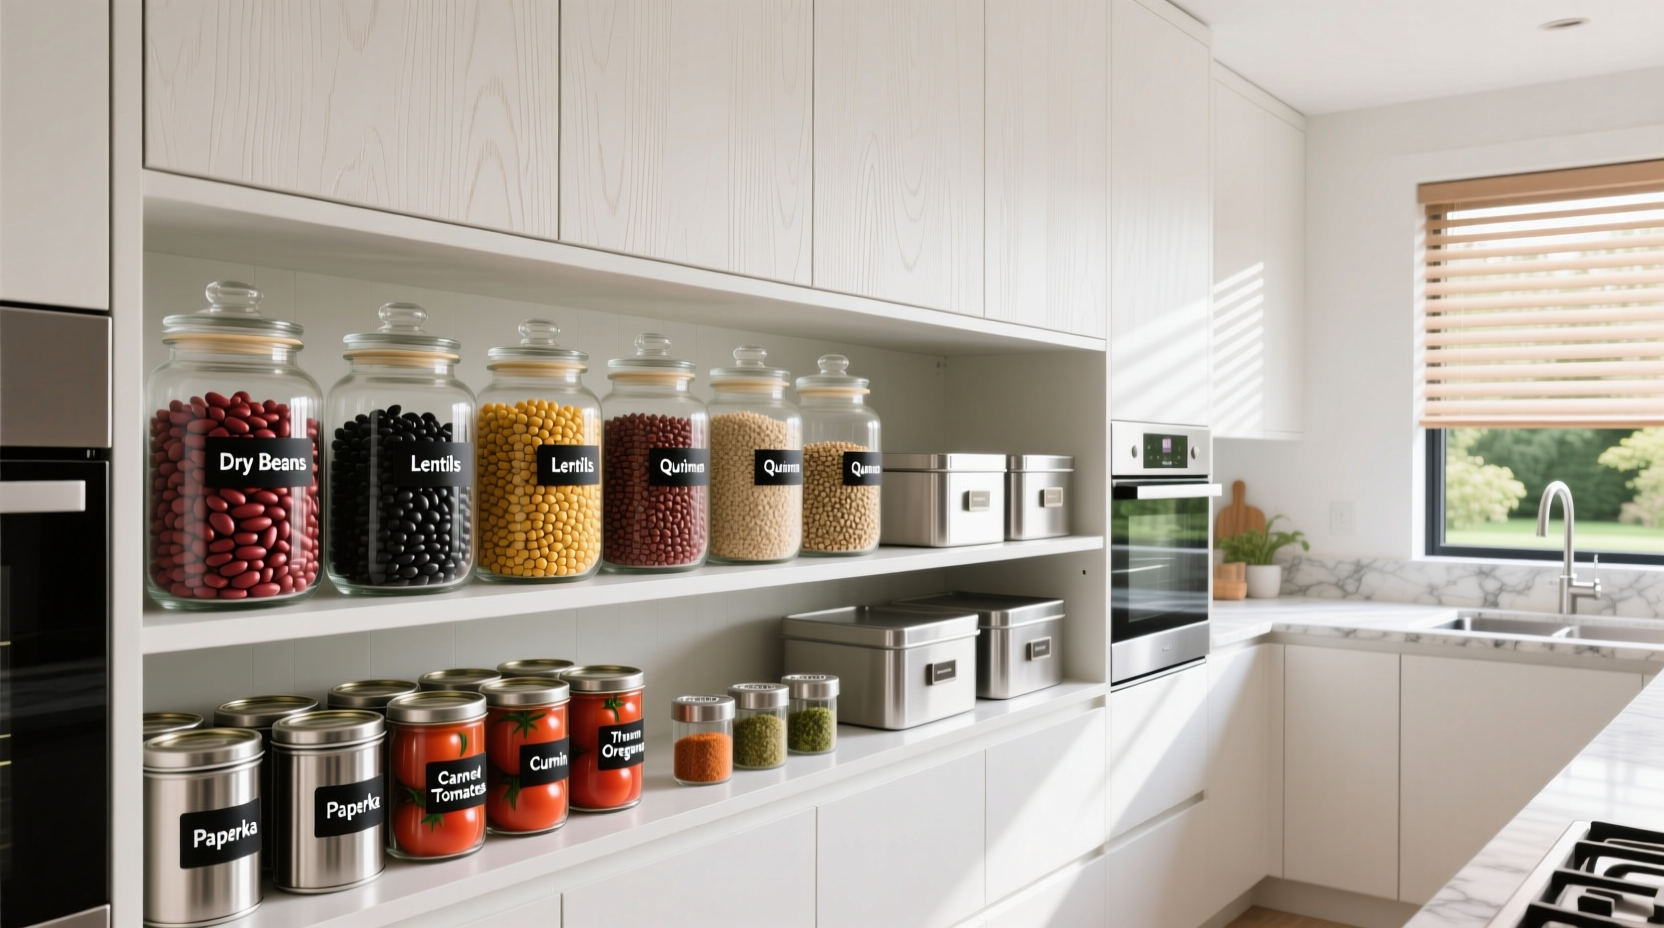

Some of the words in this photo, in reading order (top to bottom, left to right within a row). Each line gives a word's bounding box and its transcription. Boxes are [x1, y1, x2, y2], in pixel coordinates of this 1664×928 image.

[219, 452, 253, 476] Dry
[258, 452, 307, 471] Beans
[411, 454, 462, 473] Lentils
[193, 819, 258, 850] Paperka
